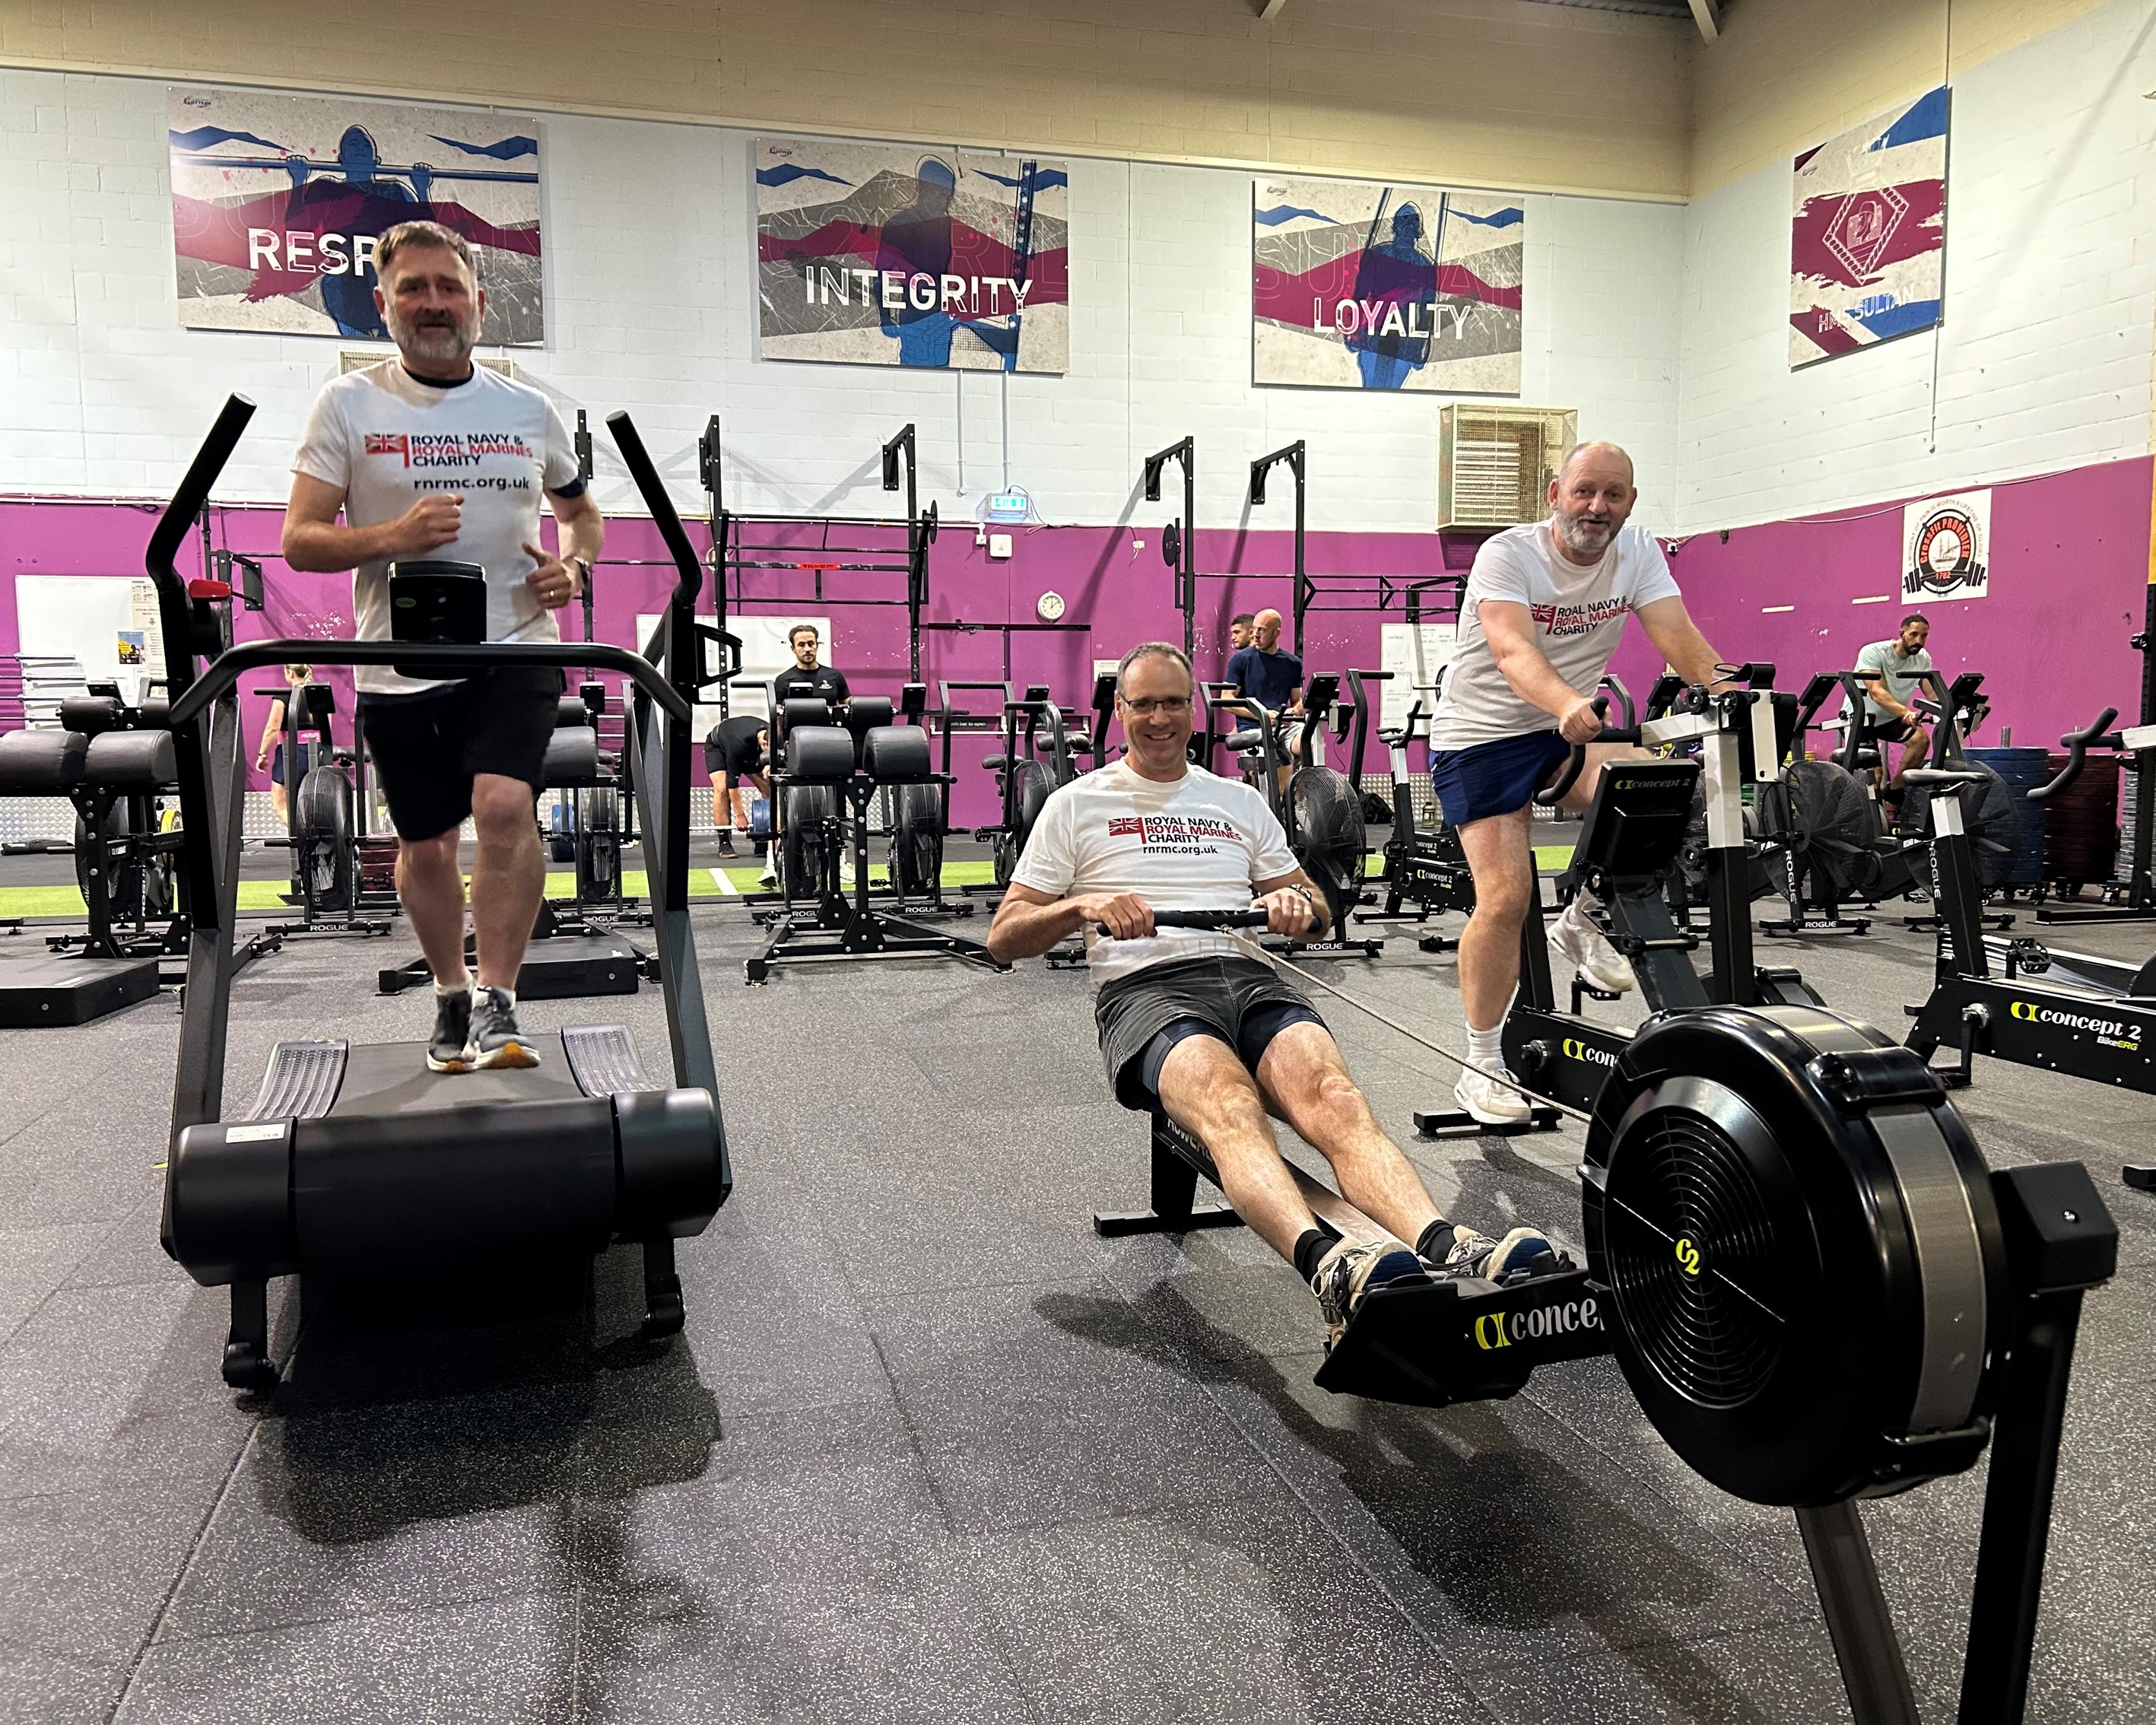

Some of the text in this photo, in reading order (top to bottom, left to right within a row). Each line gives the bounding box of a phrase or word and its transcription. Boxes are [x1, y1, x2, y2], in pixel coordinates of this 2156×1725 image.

[248, 227, 481, 277] RESP
[805, 265, 1033, 316] INTEGRITY
[1854, 282, 1914, 320] SULTAN
[1313, 297, 1472, 340] LOYALTY
[411, 434, 464, 446] ROYAL
[467, 434, 509, 444] NAVY
[412, 443, 533, 458] ROYAL MARINES
[413, 455, 481, 466] CHARITY
[414, 476, 530, 490] rnrmc.org.uk
[1935, 571, 1951, 580] 1782
[1587, 598, 1619, 612] NAVY
[1553, 622, 1598, 636] CHARITY
[1631, 778, 1691, 789] concept 2
[1145, 817, 1233, 831] ROYAL NAVY &
[1146, 825, 1242, 841] ROYAL MARINES
[1148, 834, 1200, 843] CHARITY
[1143, 845, 1219, 856] rnrmc.org.uk
[1425, 872, 1448, 882] concept
[1785, 850, 1798, 904] ROGUE
[1929, 847, 1942, 899] ROGUE
[2040, 1009, 2142, 1040] concept 2
[2097, 1035, 2139, 1051] BikeERG
[1586, 1048, 1618, 1068] con
[1675, 1238, 1700, 1275] C2
[1511, 1298, 1605, 1340] conce
